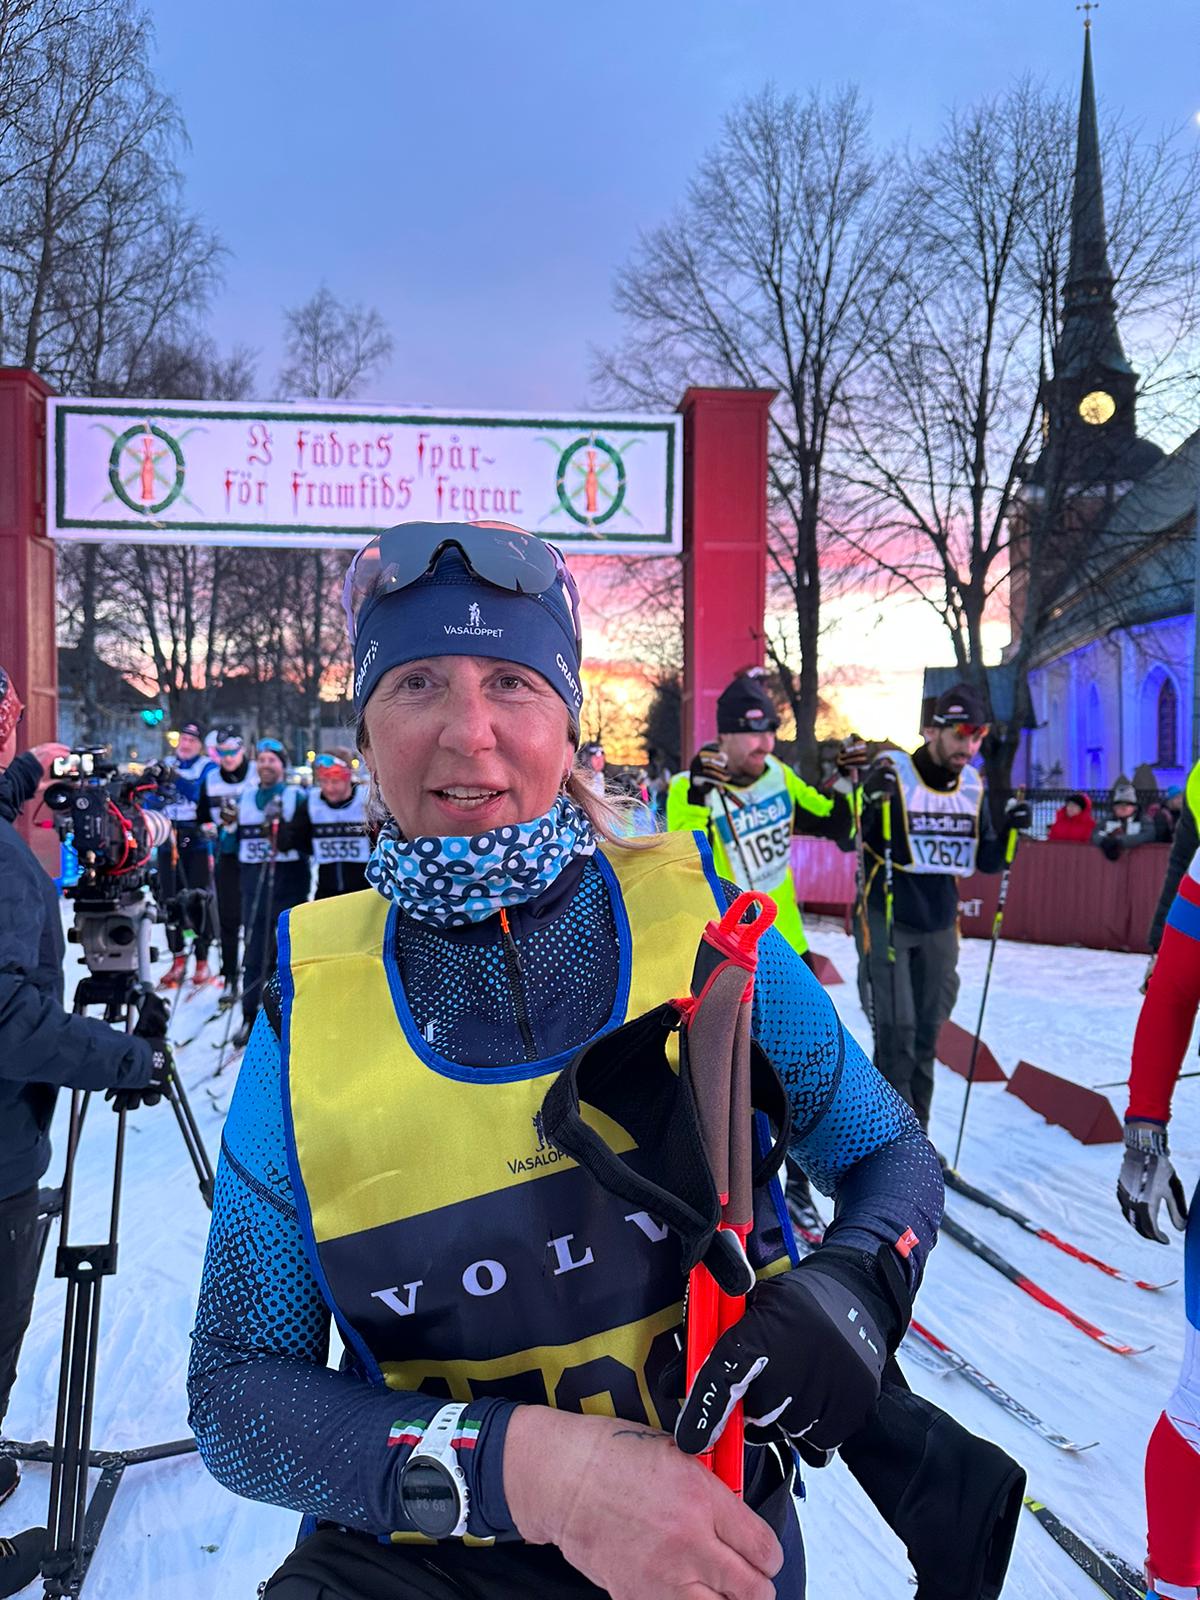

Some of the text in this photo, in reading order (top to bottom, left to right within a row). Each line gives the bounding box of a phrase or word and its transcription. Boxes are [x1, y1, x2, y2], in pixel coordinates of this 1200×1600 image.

[443, 625, 504, 638] VASALOPPET
[355, 648, 371, 697] CRAFT
[556, 653, 579, 697] CRAFT
[911, 815, 973, 832] stadium
[913, 839, 971, 868] 12627
[506, 1150, 570, 1175] VASALOP
[371, 1210, 669, 1317] VOLV
